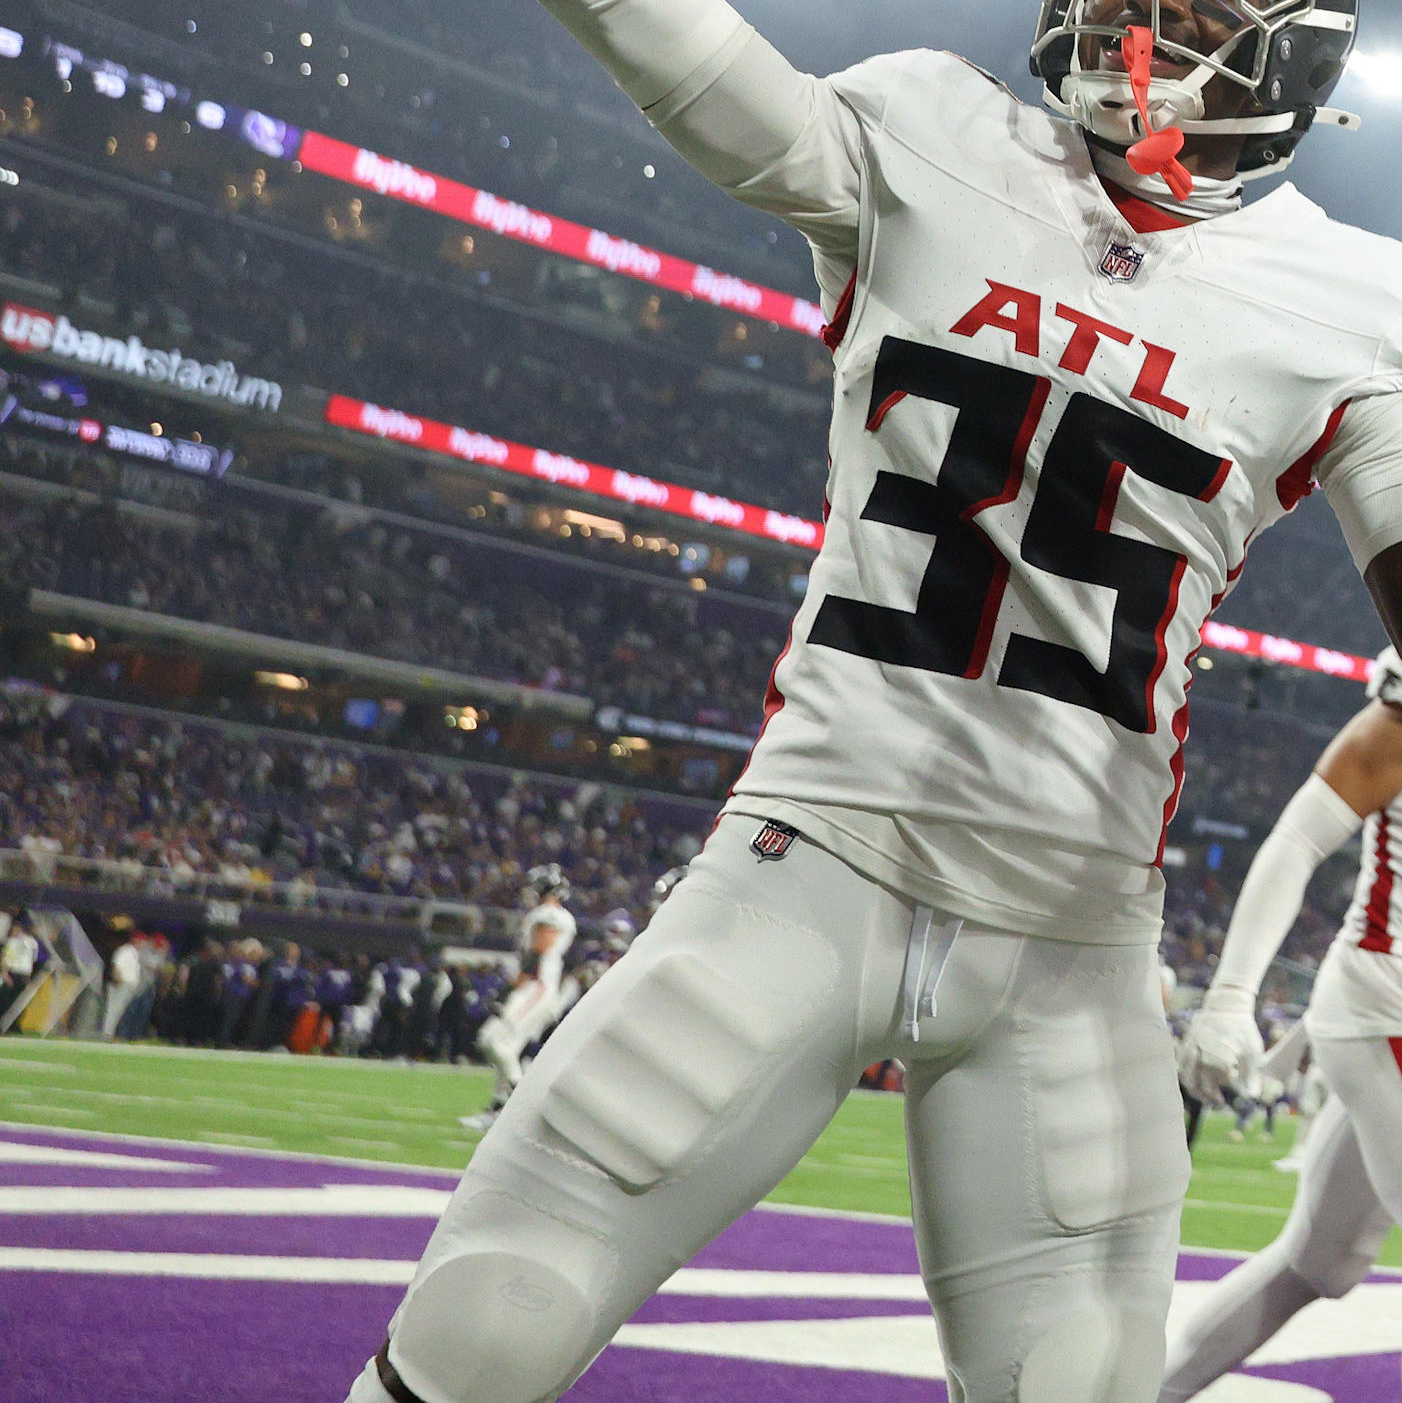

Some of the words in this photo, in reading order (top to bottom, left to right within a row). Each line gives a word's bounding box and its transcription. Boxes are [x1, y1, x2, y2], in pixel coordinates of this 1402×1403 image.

[1104, 255, 1133, 277] NFL
[949, 279, 1189, 421] ATL
[806, 335, 1232, 734] 35
[757, 828, 788, 853] NFL
